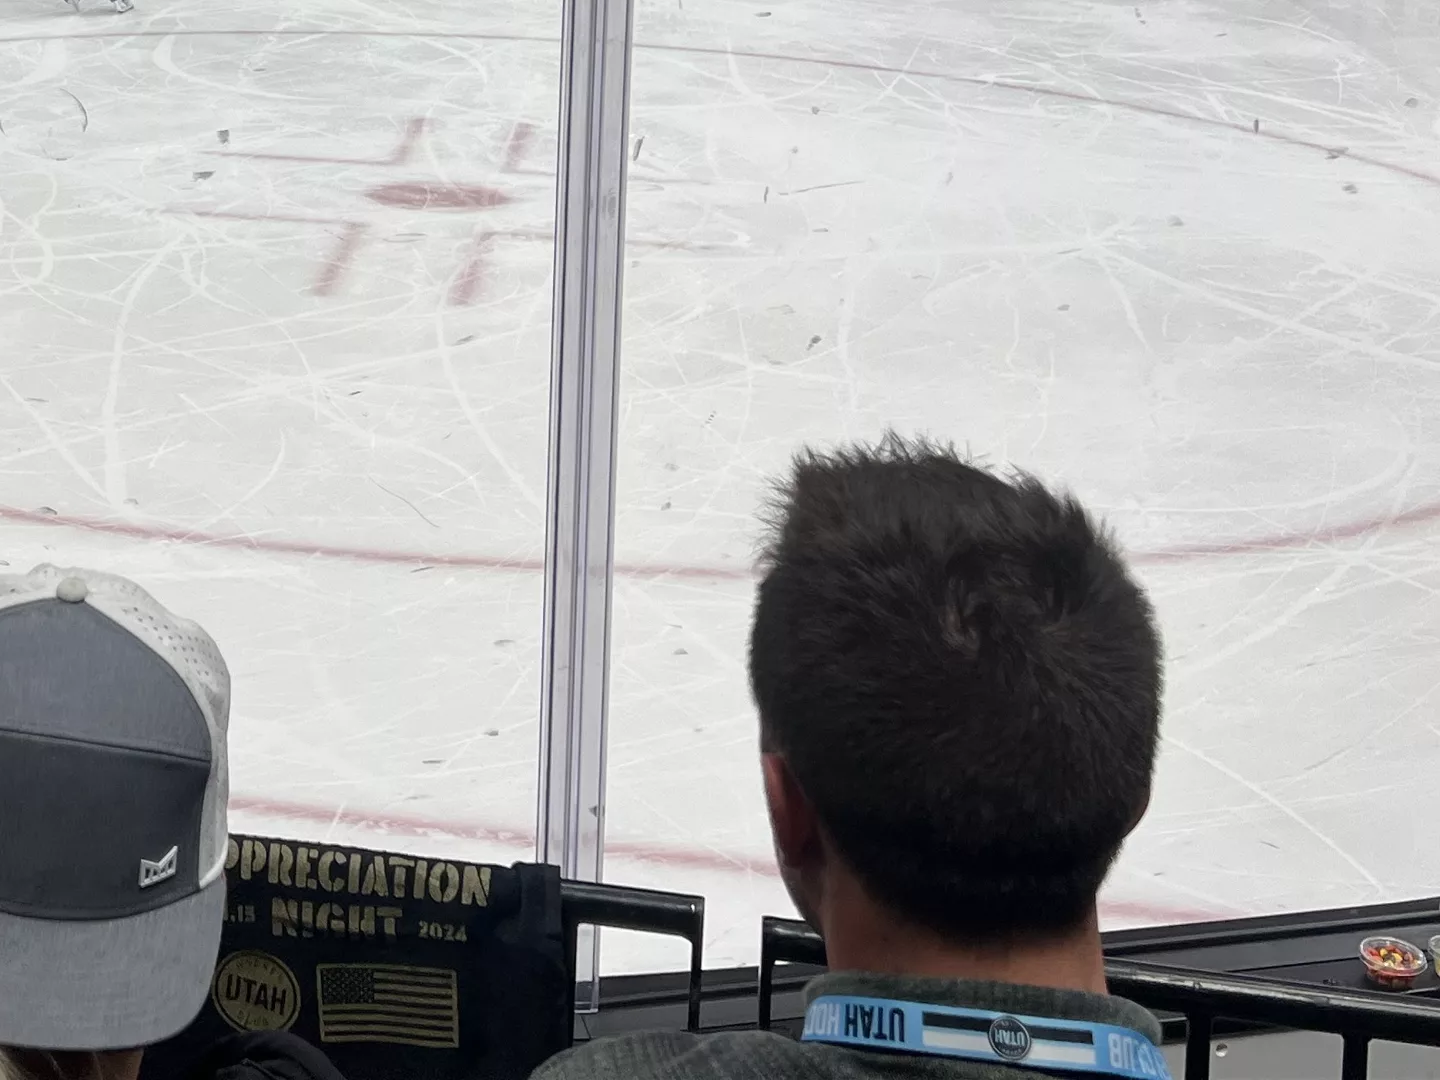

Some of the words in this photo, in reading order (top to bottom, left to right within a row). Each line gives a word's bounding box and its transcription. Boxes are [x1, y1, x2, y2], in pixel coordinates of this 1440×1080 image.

[271, 896, 403, 938] NIGHT
[418, 920, 468, 943] 2024
[224, 973, 288, 1016] UTAH
[844, 1002, 906, 1043] UTAH
